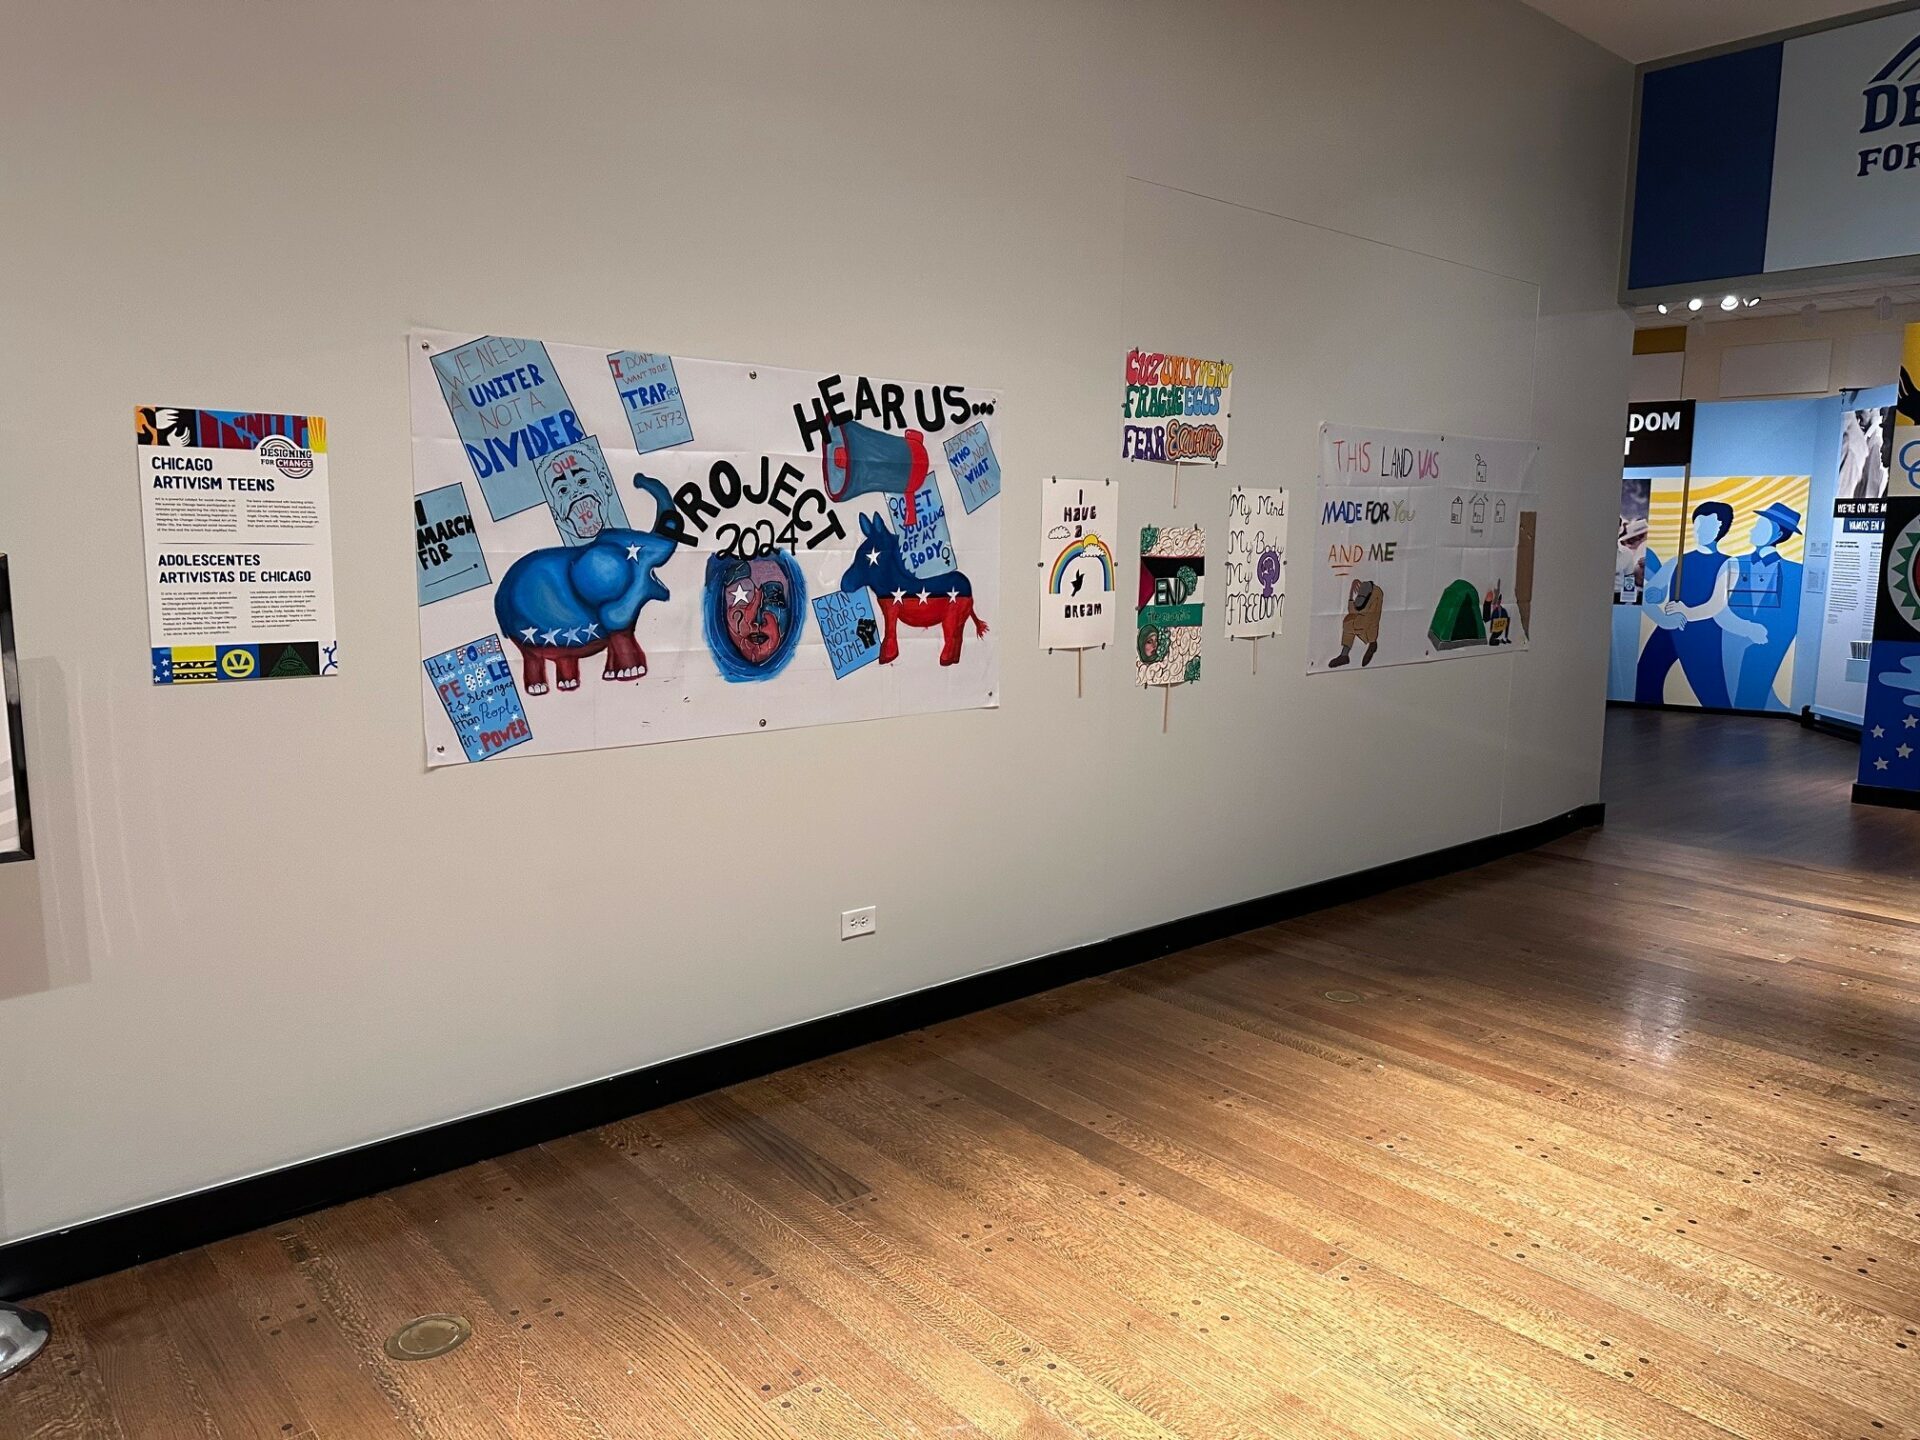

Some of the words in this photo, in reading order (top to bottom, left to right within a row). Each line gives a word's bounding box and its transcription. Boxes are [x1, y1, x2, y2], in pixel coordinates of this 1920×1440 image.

[433, 350, 481, 391] WE
[476, 337, 526, 373] NEED
[608, 359, 623, 378] I
[1126, 350, 1164, 386] CUZ
[1160, 355, 1200, 387] ONLY
[1199, 361, 1233, 388] VERY
[449, 391, 468, 417] A
[468, 363, 545, 408] UNITER
[1184, 386, 1222, 416] EGOS
[479, 397, 523, 434] NOT
[530, 391, 546, 413] A
[634, 421, 653, 434] IN
[655, 410, 685, 429] 1973
[793, 374, 907, 452] HEAR
[1629, 411, 1680, 432] DOM
[260, 448, 312, 458] DESIGNING
[465, 409, 584, 479] DIVIDER
[948, 434, 966, 454] ASK
[1123, 425, 1166, 460] FEAR
[152, 456, 213, 471] CHICAGO
[277, 459, 312, 468] CHANGE
[552, 455, 577, 475] OUR
[950, 446, 970, 467] WHO
[1333, 441, 1371, 473] THIS
[1382, 446, 1413, 479] LAND
[153, 476, 222, 490] ARTIVISM
[227, 477, 275, 491] TEENS
[965, 457, 989, 484] WHAT
[656, 456, 846, 549] PROJECT
[899, 489, 932, 521] GET
[1079, 489, 1083, 505] I
[1229, 494, 1251, 525] My
[1257, 495, 1284, 517] Mind
[1857, 503, 1867, 513] ON
[1868, 503, 1879, 513] THE
[414, 499, 427, 526] I
[579, 510, 593, 524] TO
[1322, 501, 1362, 525] MADE
[1366, 501, 1390, 525] FOR
[1849, 521, 1870, 531] VAMOS
[416, 514, 475, 550] MARCH
[716, 520, 798, 561] 2024
[899, 515, 928, 540] YOUR
[903, 534, 918, 552] OFF
[922, 525, 937, 544] MY
[158, 554, 260, 566] ADOLESCENTES
[418, 543, 453, 571] FOR
[910, 541, 943, 569] BODY
[1228, 530, 1252, 563] My
[1254, 531, 1284, 559] Body
[1328, 544, 1363, 563] AND
[1368, 542, 1397, 562] ME
[159, 571, 235, 583] ARTIVISTAS
[239, 571, 256, 582] DE
[261, 570, 311, 582] CHICAGO
[1226, 562, 1252, 594] My
[817, 592, 851, 619] SKIN
[1155, 578, 1187, 606] END
[820, 609, 851, 637] COLOR
[850, 603, 866, 621] IS
[1226, 591, 1285, 625] FREEDOM
[826, 627, 850, 652] NOT
[831, 638, 865, 670] CRIME
[427, 659, 455, 678] the
[448, 701, 464, 713] is
[454, 716, 480, 732] than
[462, 734, 477, 748] in
[479, 719, 528, 752] POWER
